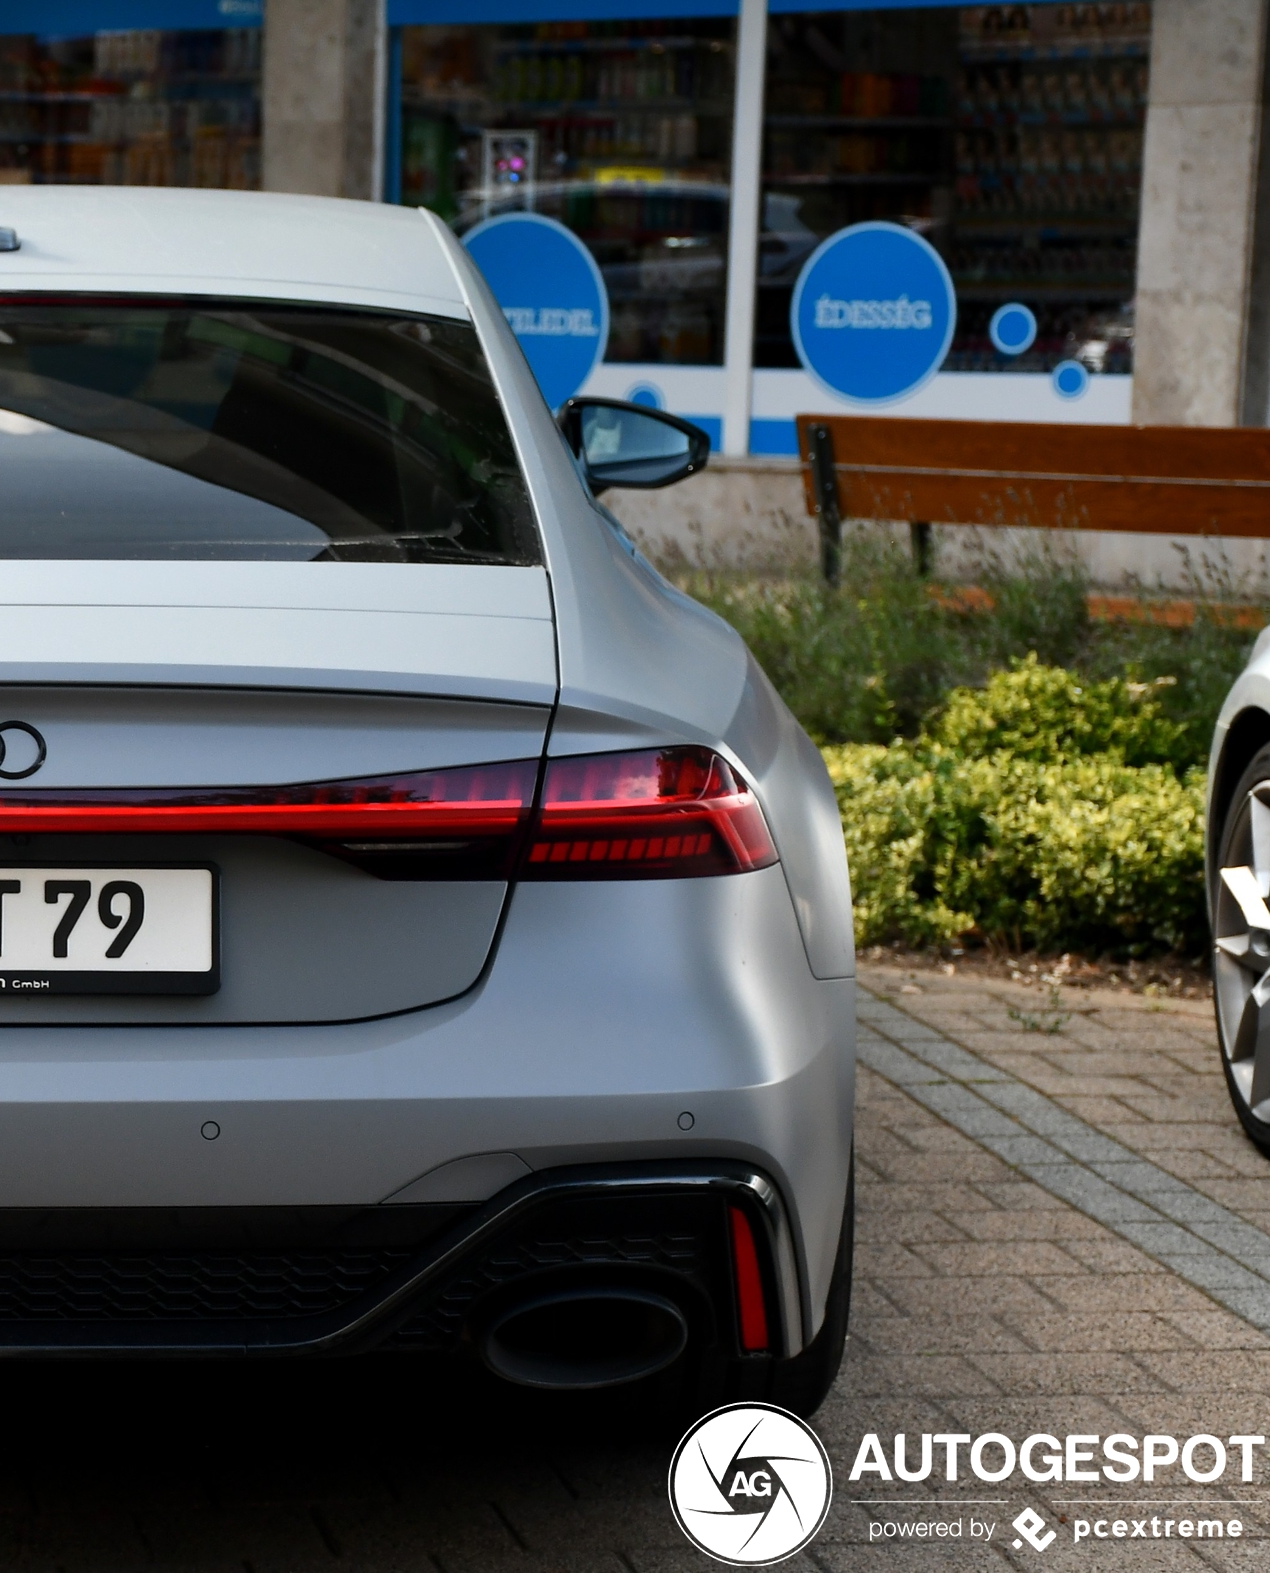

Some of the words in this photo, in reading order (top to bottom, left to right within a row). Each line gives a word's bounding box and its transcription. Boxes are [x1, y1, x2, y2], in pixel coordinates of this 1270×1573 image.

[814, 293, 933, 330] ÉDESSÉG
[44, 879, 145, 958] 79
[12, 979, 50, 989] GmbH
